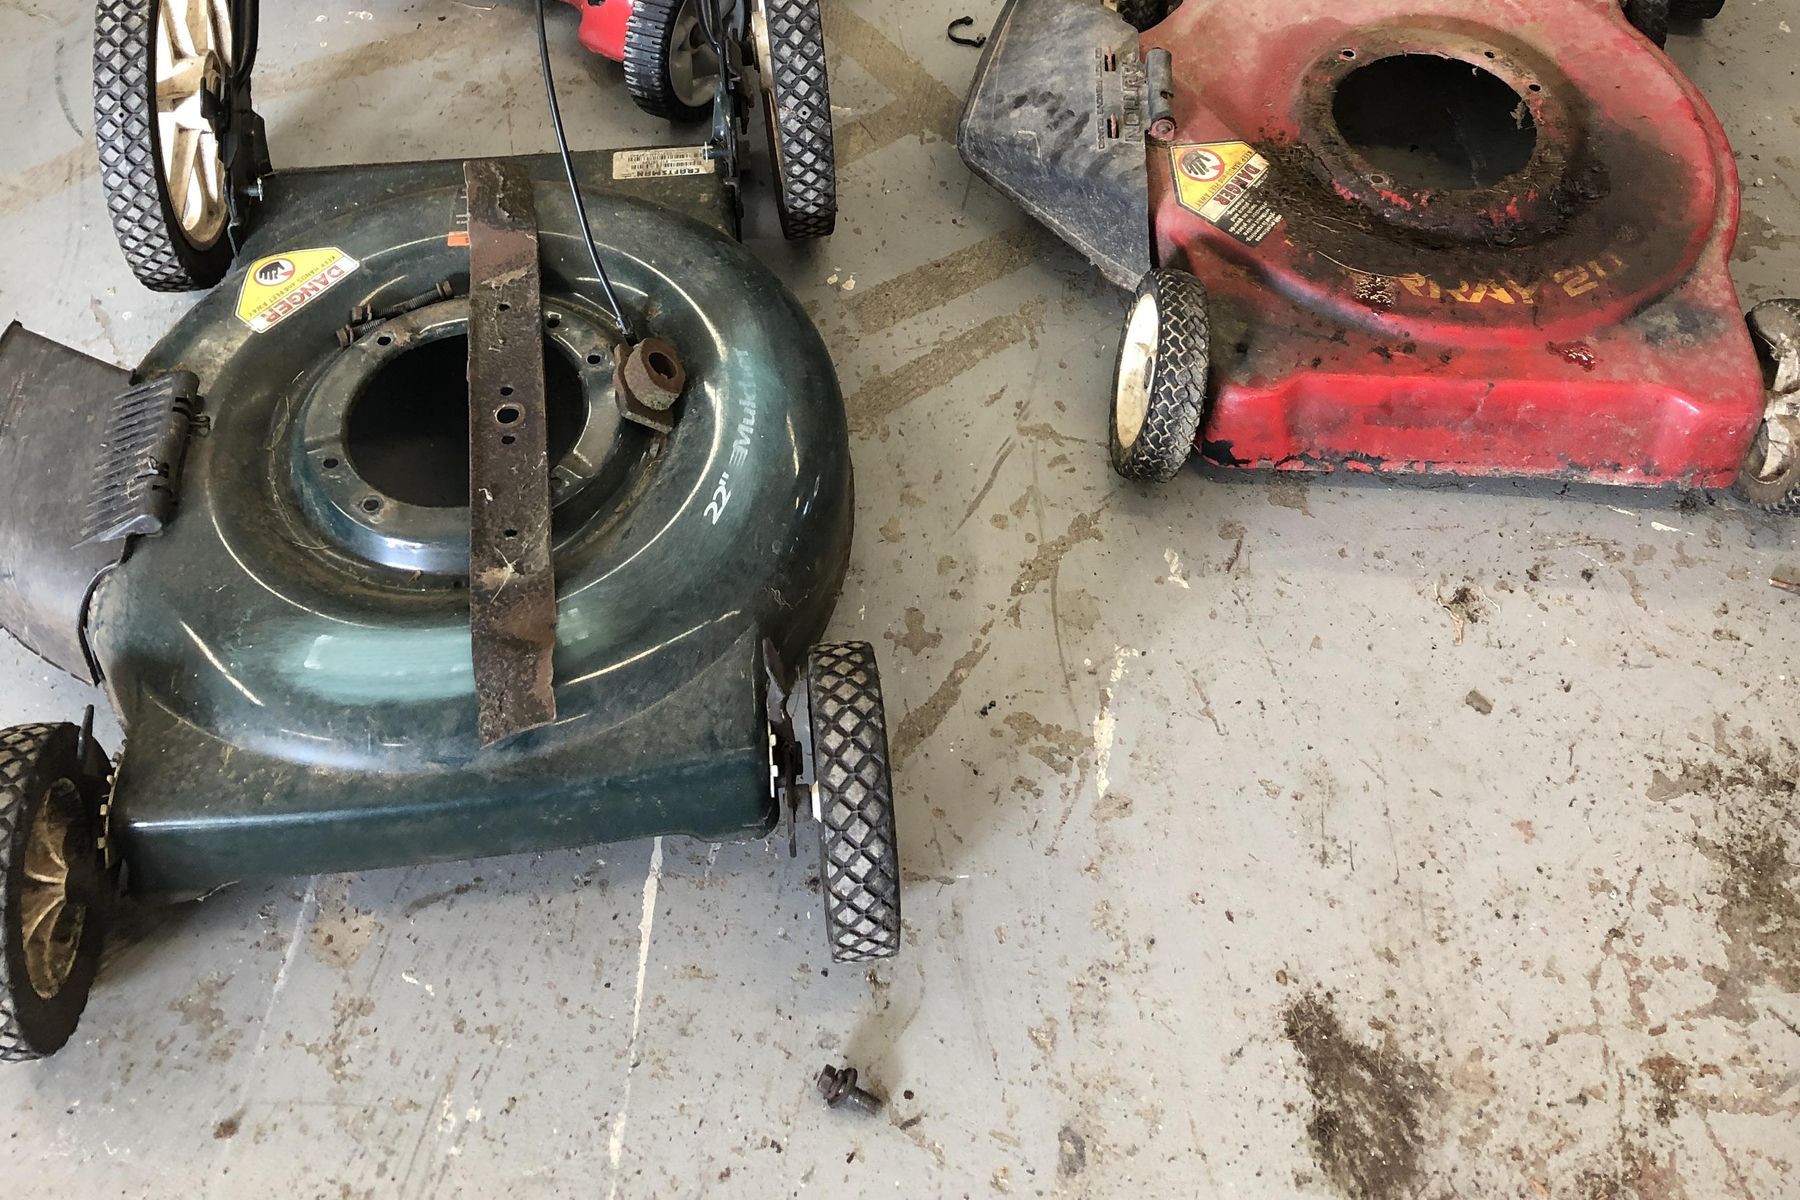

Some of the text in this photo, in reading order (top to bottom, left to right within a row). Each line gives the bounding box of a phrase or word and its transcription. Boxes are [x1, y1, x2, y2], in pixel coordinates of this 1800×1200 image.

[1121, 51, 1142, 142] CAUTION
[636, 167, 701, 177] CRAFTSMAN
[1213, 163, 1260, 205] DANGER
[262, 264, 345, 323] DANGER
[703, 471, 732, 525] 22"
